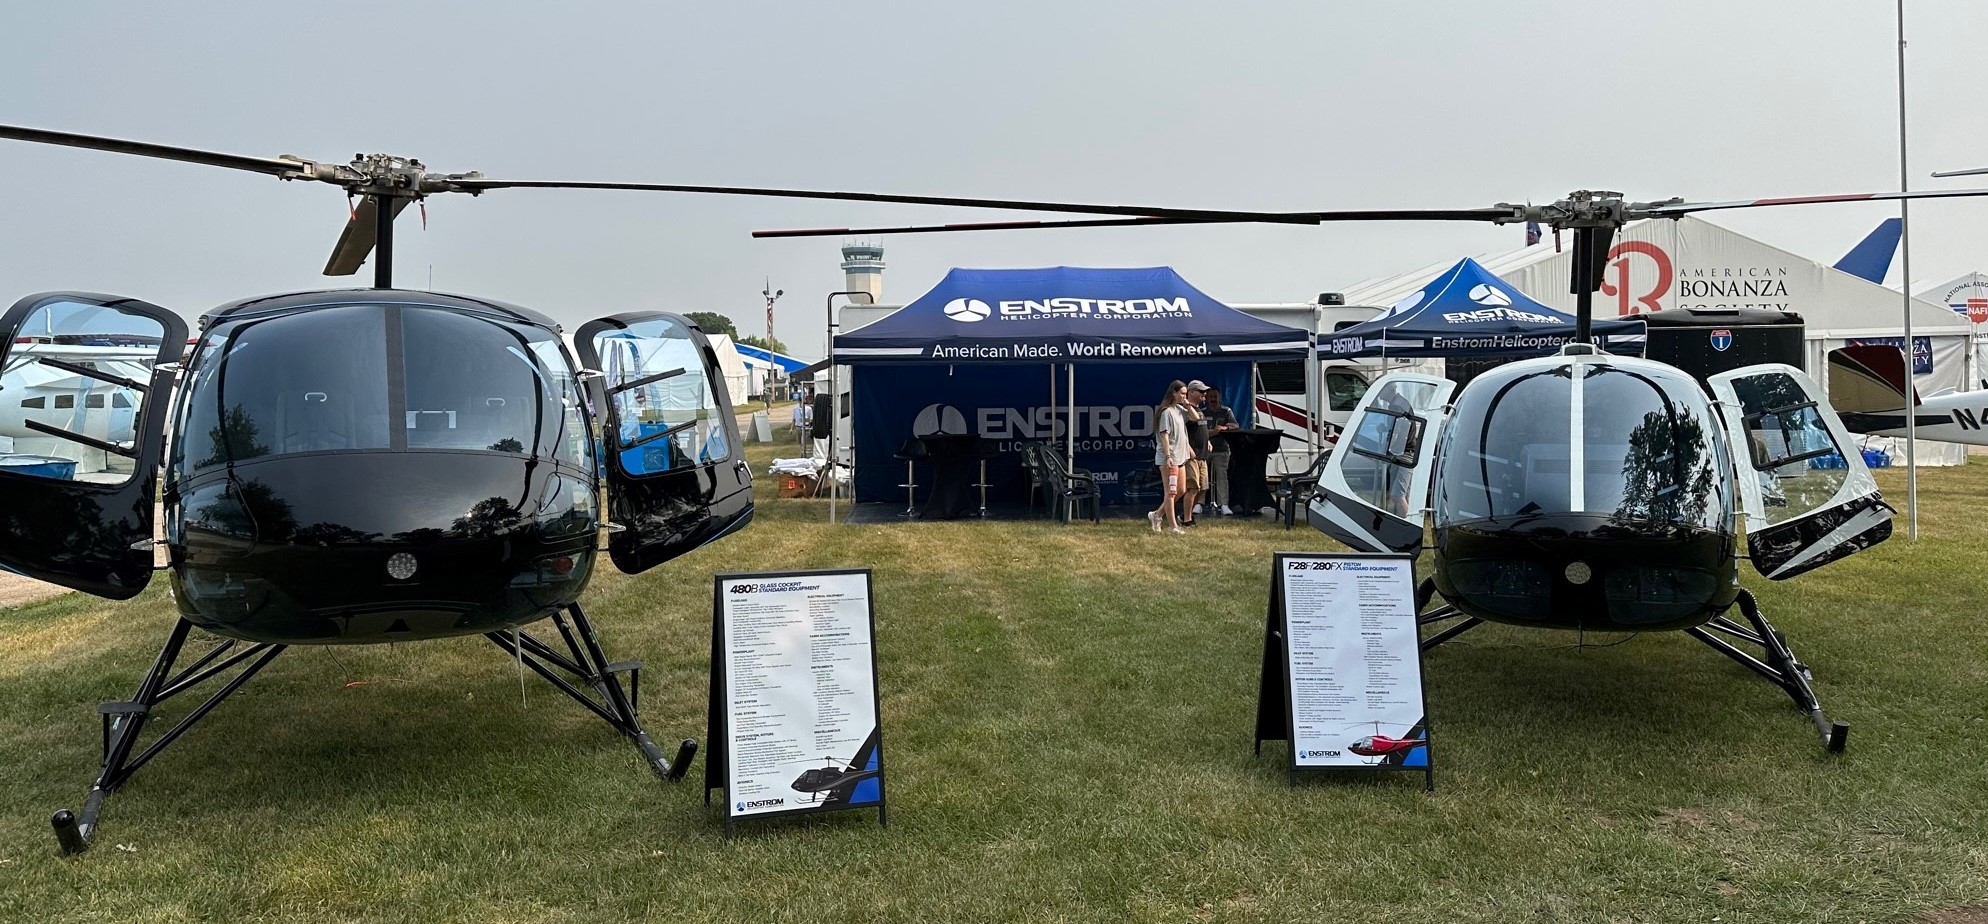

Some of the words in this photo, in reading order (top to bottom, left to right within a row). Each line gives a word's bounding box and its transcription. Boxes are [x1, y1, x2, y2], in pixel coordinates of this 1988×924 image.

[1679, 267, 1787, 277] AMERICAN
[1680, 279, 1789, 298] BONANZA
[1944, 282, 1971, 303] NATIONAL
[999, 297, 1191, 315] ENSTROM
[1968, 307, 1988, 315] NAFI
[1000, 312, 1087, 321] HELICOPTER
[1093, 312, 1193, 320] CORPORATION
[1442, 307, 1563, 323] ENSTROM
[1332, 336, 1363, 354] ENSTROM
[1432, 334, 1600, 349] EnstromHelicopter.cm
[932, 344, 1008, 358] American
[1013, 343, 1062, 358] Made.
[1066, 342, 1115, 357] World
[1120, 342, 1212, 357] Renowned.
[977, 404, 1158, 440] ENSTRO
[730, 584, 759, 594] 480B
[746, 798, 784, 808] ENSTROM
